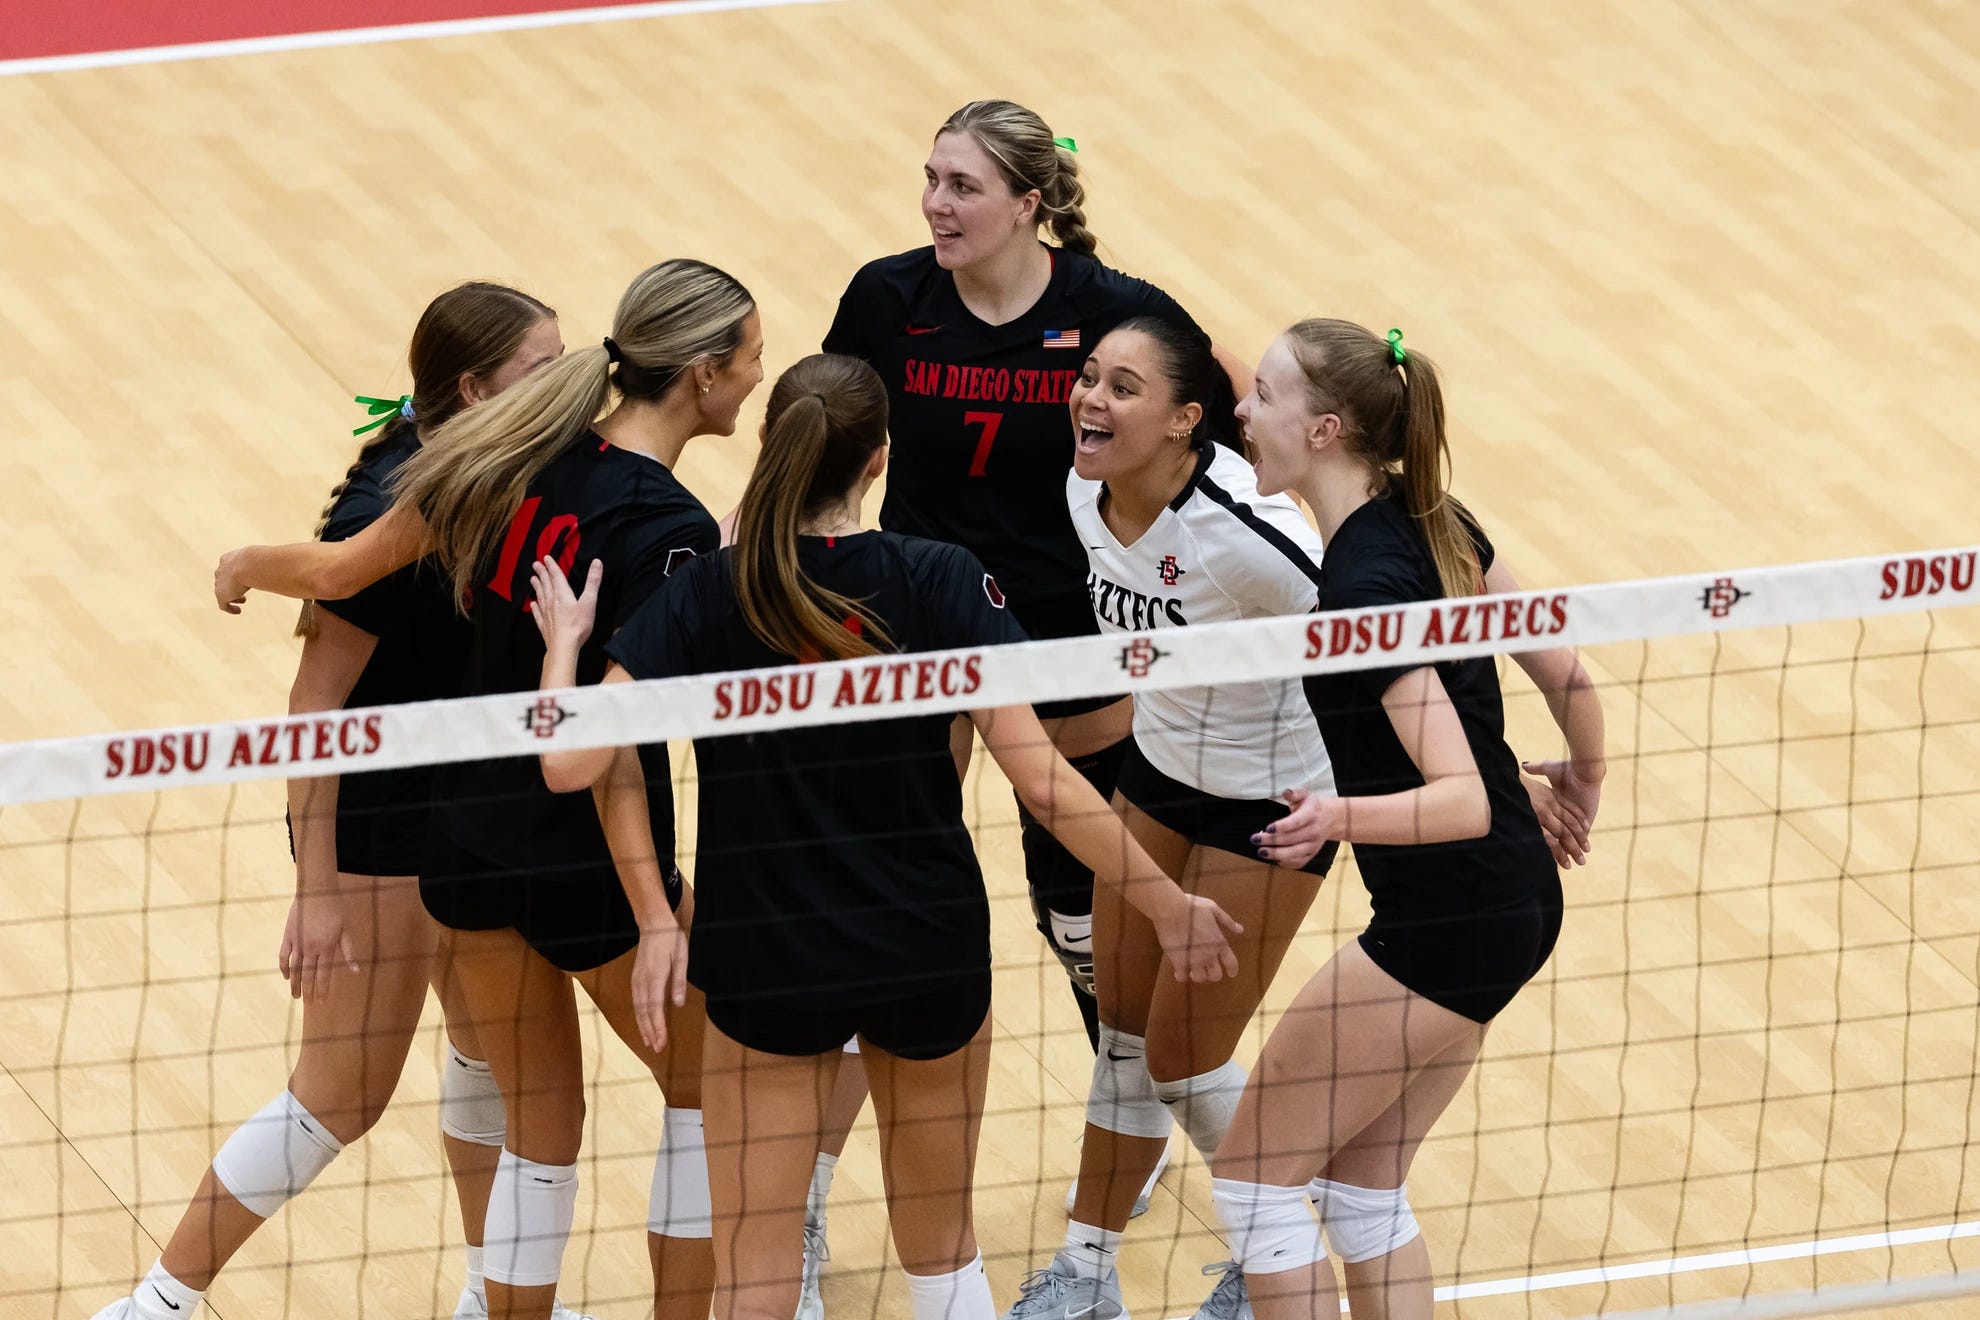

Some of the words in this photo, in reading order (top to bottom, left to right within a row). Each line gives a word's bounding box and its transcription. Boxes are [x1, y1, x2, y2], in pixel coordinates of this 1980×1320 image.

[904, 358, 942, 396] SAN
[943, 364, 1011, 403] DIEGO
[1012, 368, 1077, 404] STATE
[963, 410, 1004, 476] 7
[1880, 553, 1977, 600] SDSU
[1305, 611, 1404, 660] SDSU
[1420, 594, 1569, 647] AZTECS
[713, 671, 816, 720] SDSU
[832, 653, 982, 708] AZTECS
[105, 731, 210, 779] SDSU
[227, 714, 383, 768] AZTECS
